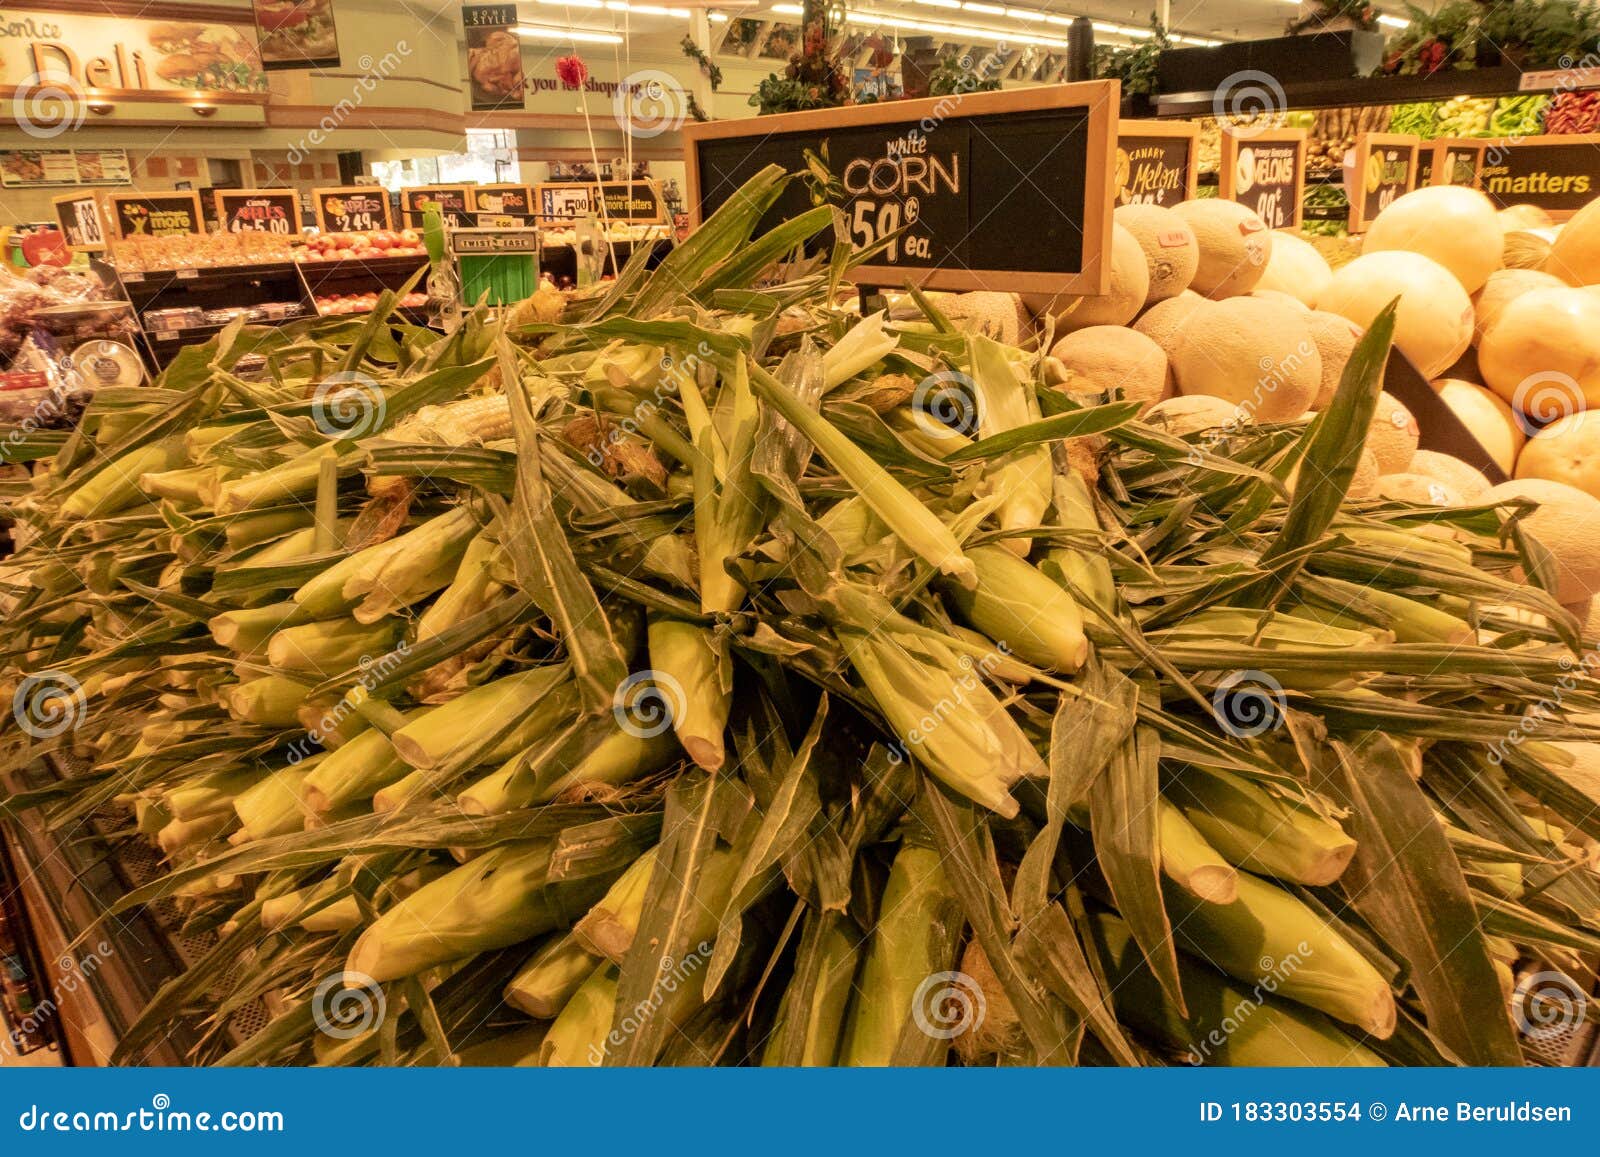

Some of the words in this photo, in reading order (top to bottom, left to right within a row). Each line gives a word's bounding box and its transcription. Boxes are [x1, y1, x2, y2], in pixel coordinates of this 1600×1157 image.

[473, 15, 507, 25] STYLE
[28, 40, 149, 89] Deli
[530, 77, 558, 96] you
[886, 135, 927, 154] white
[1129, 147, 1166, 161] CANARY
[844, 153, 959, 195] CORN
[1132, 161, 1181, 194] Melon
[1254, 157, 1294, 185] MELONS
[1489, 171, 1590, 193] matters
[151, 215, 191, 228] more
[462, 240, 490, 248] TWIST
